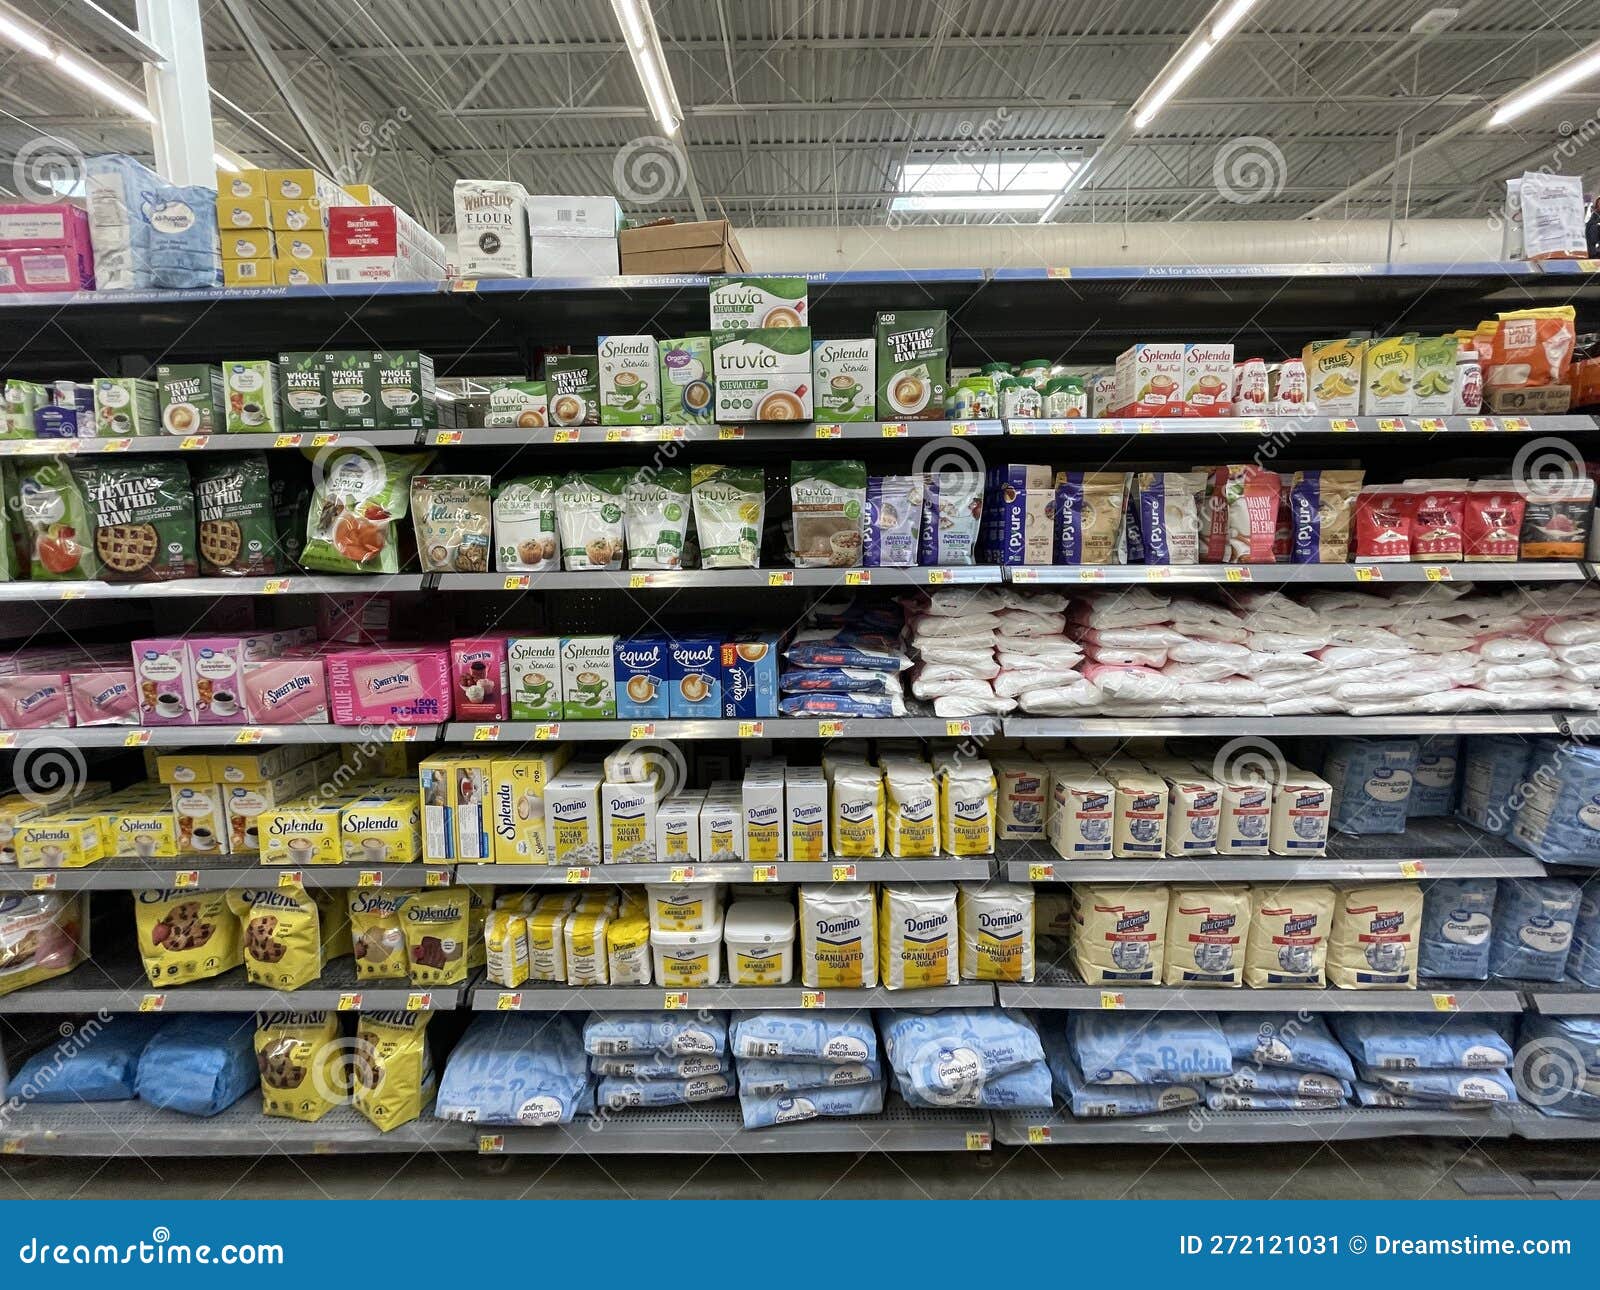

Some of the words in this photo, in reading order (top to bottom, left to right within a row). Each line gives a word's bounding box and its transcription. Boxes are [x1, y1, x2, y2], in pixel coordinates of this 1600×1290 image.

[465, 212, 513, 226] FLOUR
[1149, 268, 1167, 276] Ask
[1169, 267, 1183, 275] for
[1185, 267, 1237, 276] assistance
[1238, 266, 1259, 276] with
[643, 275, 694, 285] assistance
[158, 287, 180, 299] with
[181, 288, 210, 299] items
[210, 289, 223, 297] on
[225, 287, 242, 296] the
[243, 287, 258, 297] top
[260, 285, 287, 295] shelf.
[881, 313, 895, 322] 400
[1507, 326, 1533, 336] DATE
[887, 330, 927, 347] STEVIA
[1508, 335, 1532, 346] LADY
[601, 341, 649, 358] Splenda
[896, 342, 911, 353] IN
[912, 338, 933, 350] THE
[821, 346, 869, 363] Splenda
[895, 350, 917, 363] RAW
[1138, 349, 1182, 363] Splenda
[1187, 349, 1231, 363] Splenda
[1322, 353, 1348, 365] TRUE
[1378, 351, 1402, 362] TRUE
[287, 372, 320, 381] WHOLE
[331, 370, 364, 378] WHOLE
[379, 370, 412, 378] WHOLE
[287, 379, 320, 387] EARTH
[332, 377, 364, 385] EARTH
[380, 377, 411, 385] EARTH
[721, 381, 744, 390] STEVIA
[744, 381, 762, 389] LEAF
[557, 386, 577, 396] RAW
[170, 394, 188, 404] RAW
[118, 491, 157, 508] THE
[218, 490, 243, 504] THE
[1248, 495, 1271, 509] MONK
[97, 508, 134, 528] RAW
[200, 506, 225, 522] RAW
[1249, 508, 1271, 522] FRUIT
[1251, 521, 1276, 534] BLEND
[511, 643, 556, 661] Splenda
[564, 643, 610, 660] Splenda
[619, 645, 662, 666] equal
[673, 645, 715, 665] equal
[529, 661, 556, 671] Stevia
[339, 660, 353, 690] PACK
[733, 666, 744, 701] equal
[339, 690, 353, 723] VALUE
[391, 706, 438, 715] PACKETS
[726, 702, 734, 717] 800
[553, 800, 587, 815] Domino
[611, 796, 645, 812] Domino
[840, 801, 873, 815] Domino
[900, 798, 933, 814] Domino
[497, 785, 516, 841] Splenda
[748, 807, 778, 819] Domino
[792, 805, 822, 818] Domino
[119, 819, 163, 834] Splenda
[269, 816, 324, 835] Splenda
[343, 814, 399, 834] Splenda
[666, 820, 688, 830] Domino
[711, 820, 733, 829] Domino
[24, 829, 70, 843] Splenda
[559, 830, 582, 838] SUGAR
[792, 830, 824, 838] GRANULATED
[840, 828, 876, 836] GRANULATED
[899, 827, 935, 836] GRANULATED
[953, 827, 990, 835] GRANULATED
[559, 837, 583, 845] PACKETS
[616, 834, 641, 842] PACKETS
[670, 894, 689, 902] Domino
[407, 904, 460, 922] Splenda
[664, 909, 696, 917] GRANULATED
[816, 918, 860, 935] Domino
[904, 914, 948, 933] Domino
[978, 912, 1023, 929] Domino
[1117, 919, 1131, 932] DIXIE
[1130, 913, 1150, 927] CRYSTALS
[1201, 921, 1215, 933] DIXIE
[1215, 914, 1235, 930] CRYSTALS
[1285, 922, 1298, 934] DIXIE
[1297, 916, 1317, 930] CRYSTALS
[1371, 920, 1384, 933] DIXIE
[1384, 913, 1404, 928] CRYSTALS
[613, 941, 637, 952] Domino
[750, 948, 769, 957] Domino
[976, 944, 1025, 957] GRANULATED
[676, 950, 695, 958] Domino
[814, 952, 864, 962] GRANULATED
[901, 948, 950, 962] GRANULATED
[990, 954, 1011, 964] SUGAR
[670, 963, 702, 971] GRANULATED
[744, 962, 776, 970] GRANULATED
[828, 960, 850, 968] SUGAR
[915, 960, 937, 968] SUGAR
[829, 1042, 849, 1052] Sugar
[828, 1049, 867, 1059] Granulated
[683, 1063, 720, 1073] Granulated
[940, 1061, 979, 1078] Granulated
[689, 1084, 728, 1097] Granulated
[523, 1102, 544, 1113] Sugar
[522, 1109, 561, 1121] Granulated
[777, 1110, 815, 1123] Granulated
